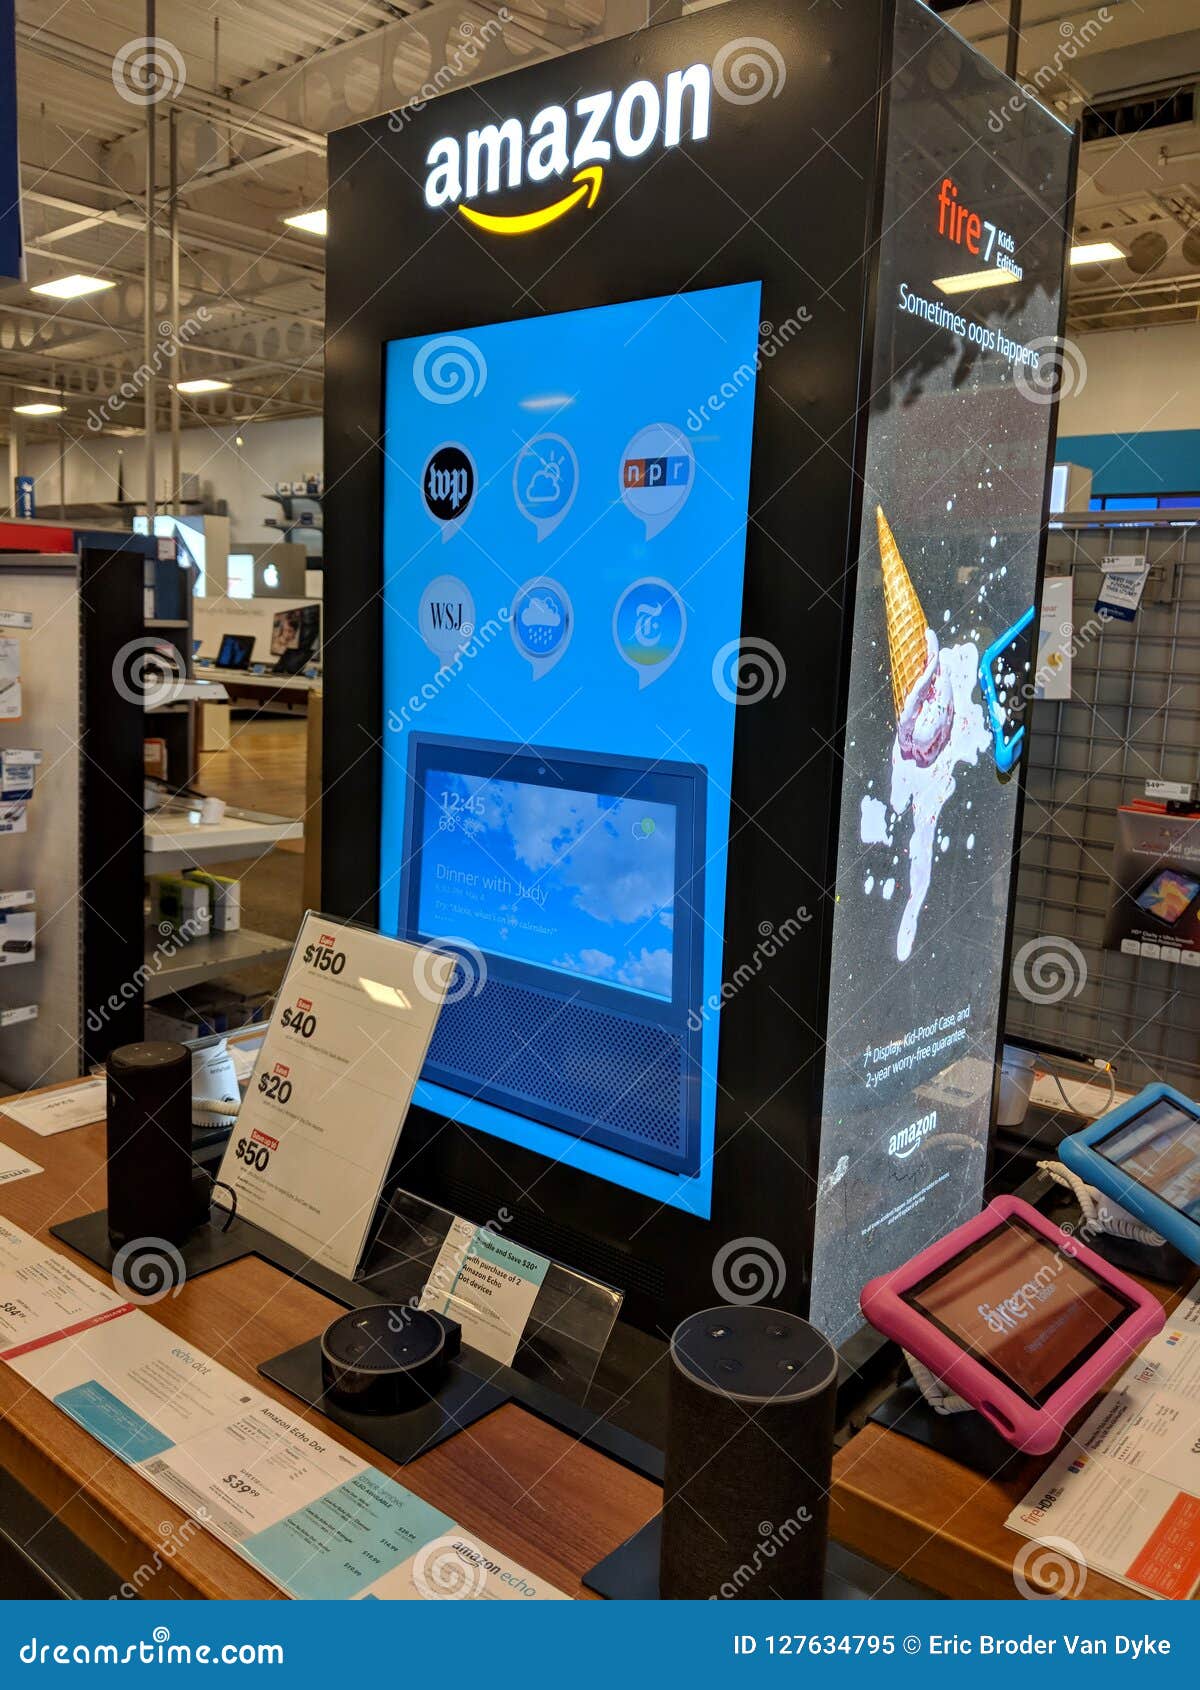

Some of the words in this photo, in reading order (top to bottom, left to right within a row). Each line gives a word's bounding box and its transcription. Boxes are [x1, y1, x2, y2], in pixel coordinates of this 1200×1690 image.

[424, 63, 712, 207] amazon
[937, 177, 982, 255] fire
[997, 229, 1015, 253] Kids
[996, 252, 1023, 282] Edition
[898, 283, 966, 337] Sometimes
[968, 322, 995, 352] oops
[996, 328, 1040, 369] happens
[626, 459, 685, 487] npr
[430, 601, 464, 632] WSJ
[441, 791, 486, 816] 12:45
[436, 863, 479, 887] Dinner
[482, 876, 512, 896] with
[515, 880, 549, 907] Judy
[303, 943, 347, 975] $150
[280, 1007, 317, 1039] $40
[903, 1018, 938, 1048] Kid-Proof
[957, 1003, 970, 1021] and
[865, 1064, 892, 1088] 2-year
[892, 1046, 931, 1074] worry-free
[931, 1028, 966, 1057] guarantee
[258, 1071, 293, 1105] $20
[888, 1110, 937, 1156] amazon
[235, 1137, 270, 1172] $50
[466, 1254, 480, 1265] with
[480, 1261, 508, 1280] purchase
[507, 1274, 517, 1283] of
[516, 1278, 522, 1286] 2
[495, 1246, 508, 1257] and
[507, 1252, 522, 1265] Save
[458, 1272, 470, 1285] Dot
[469, 1279, 493, 1296] devices
[462, 1263, 486, 1281] Amazon
[486, 1276, 502, 1289] Echo
[171, 1348, 194, 1364] echo
[191, 1361, 211, 1376] dot
[260, 1407, 291, 1430] Amazon
[290, 1427, 310, 1443] Echo
[309, 1440, 326, 1454] Dot
[451, 1541, 501, 1575] amazon
[499, 1571, 537, 1597] echo
